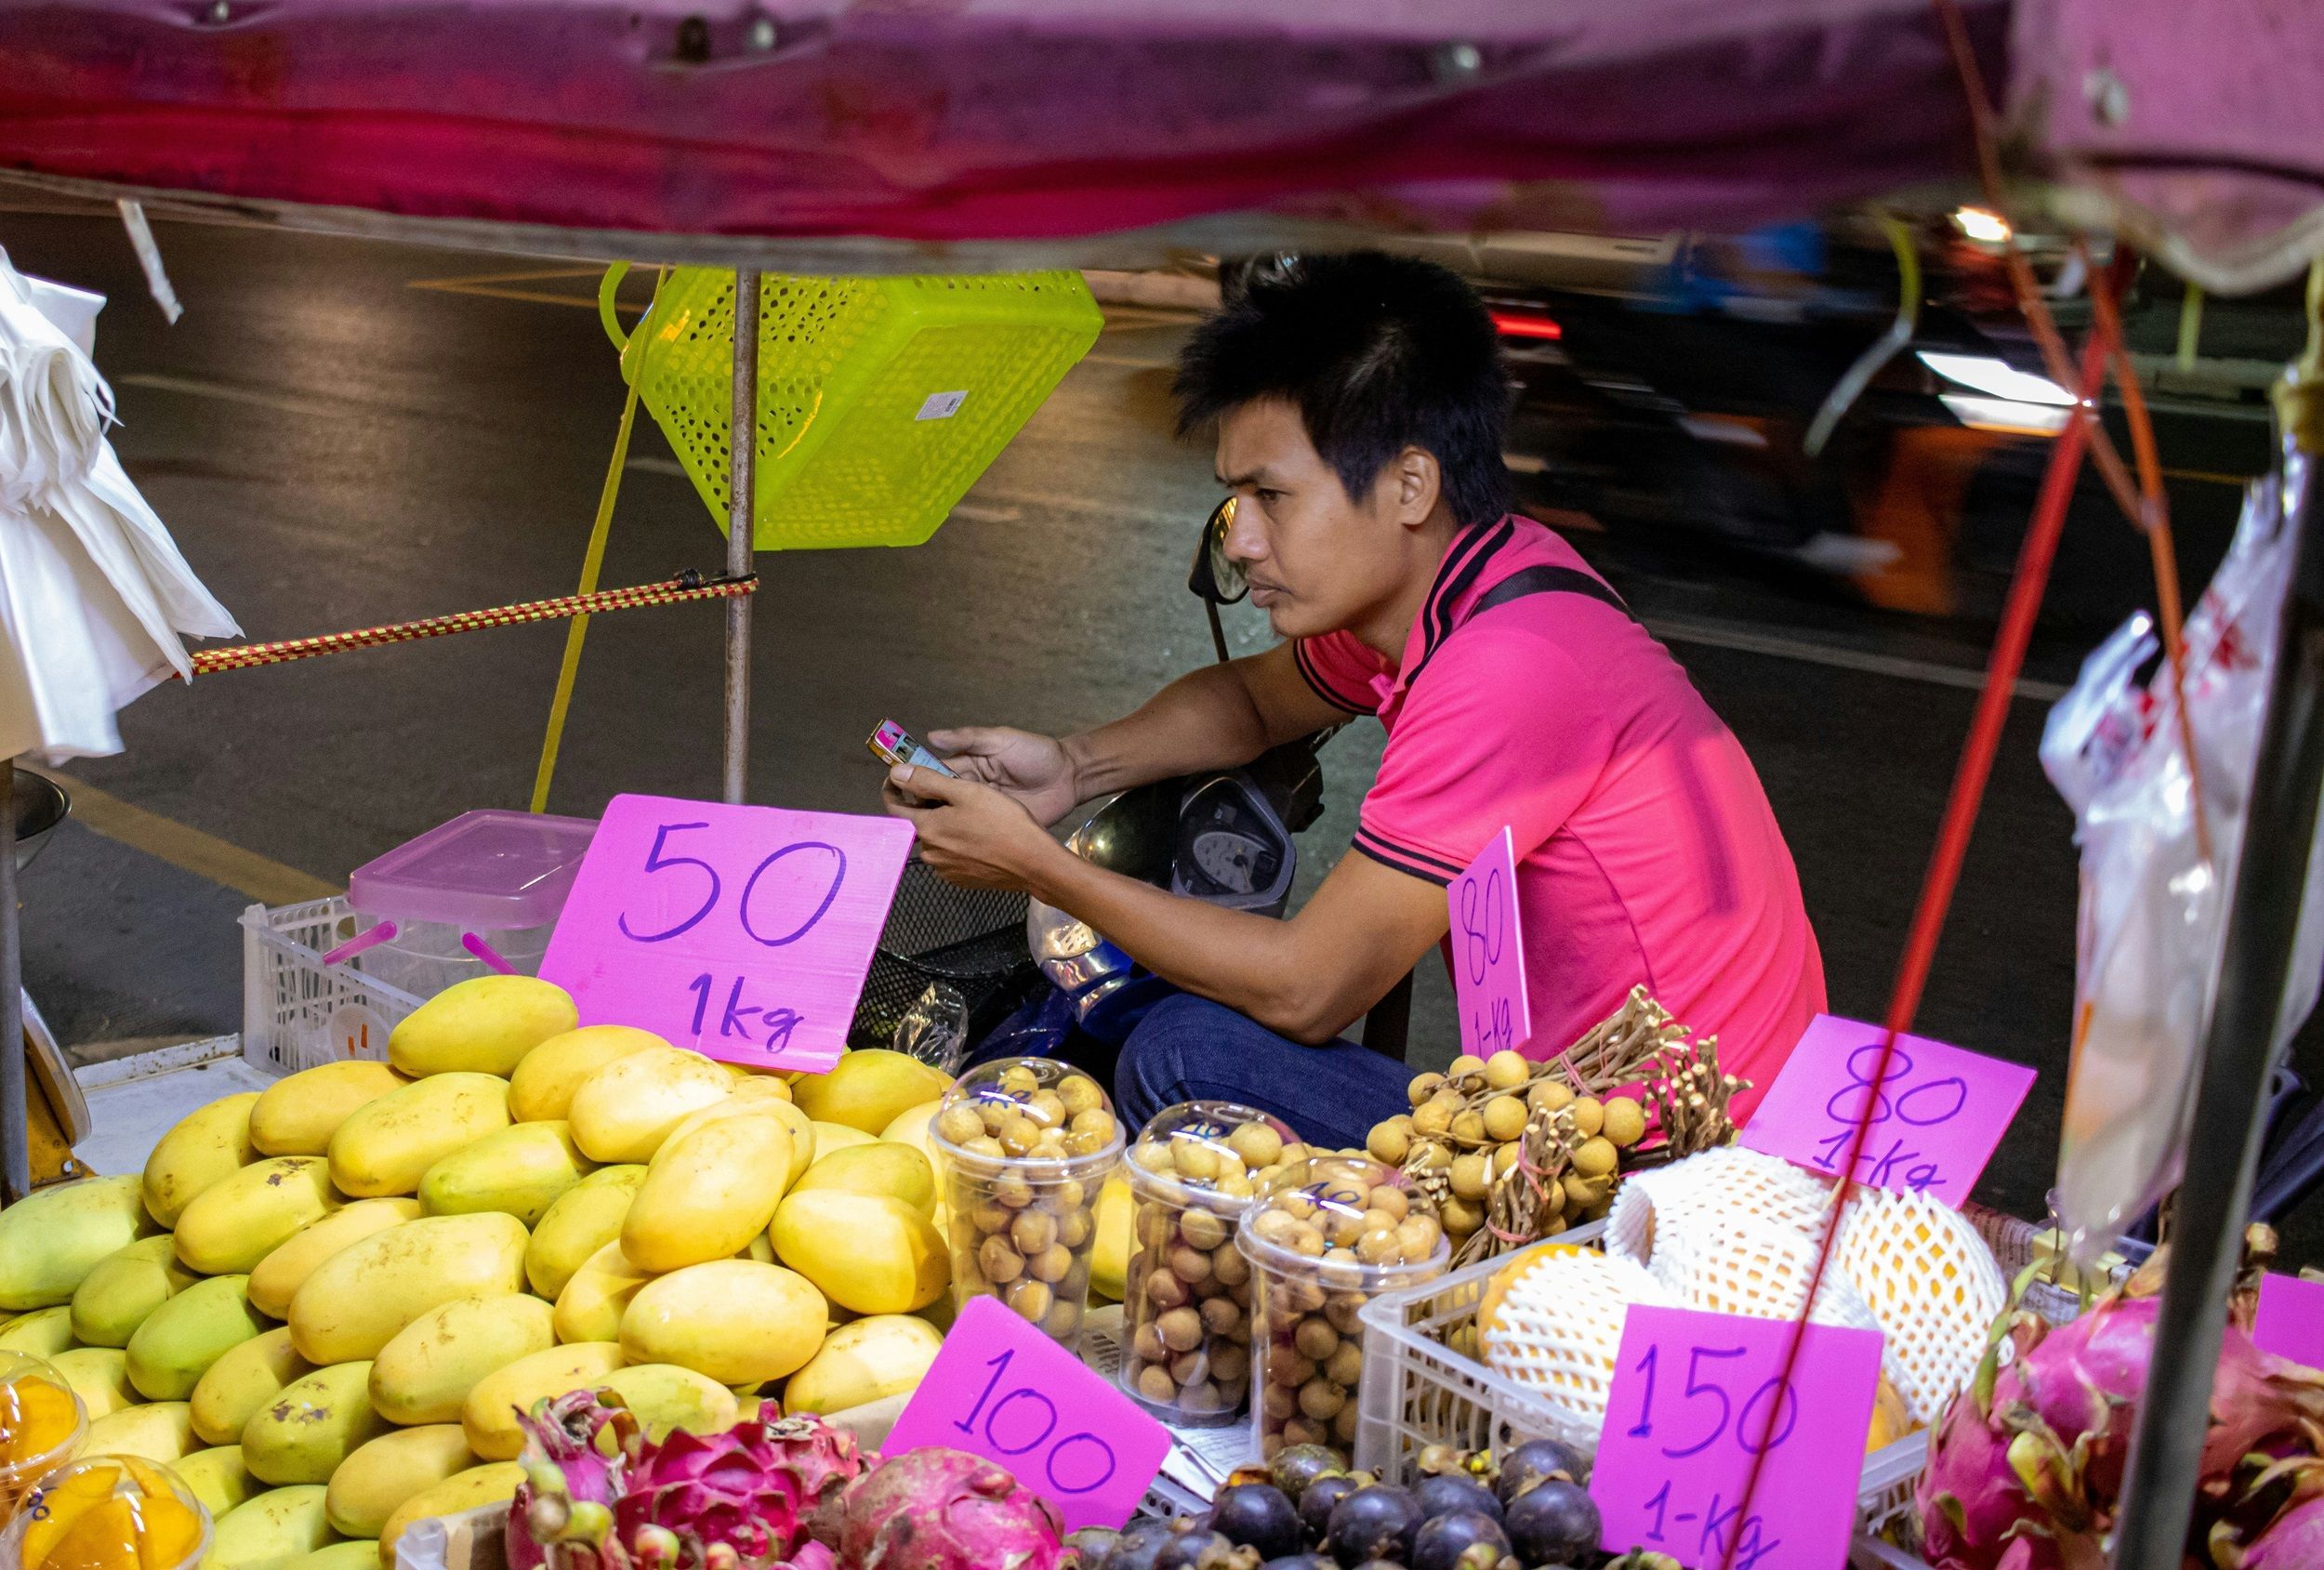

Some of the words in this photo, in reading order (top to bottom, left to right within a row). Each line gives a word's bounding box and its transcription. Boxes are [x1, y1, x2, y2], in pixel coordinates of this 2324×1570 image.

[618, 822, 847, 946] 50
[1461, 868, 1503, 986] 80
[689, 972, 806, 1053] 1kg
[1827, 1044, 1967, 1127] 80
[954, 1349, 1116, 1494] 100
[1628, 1344, 1798, 1458] 150
